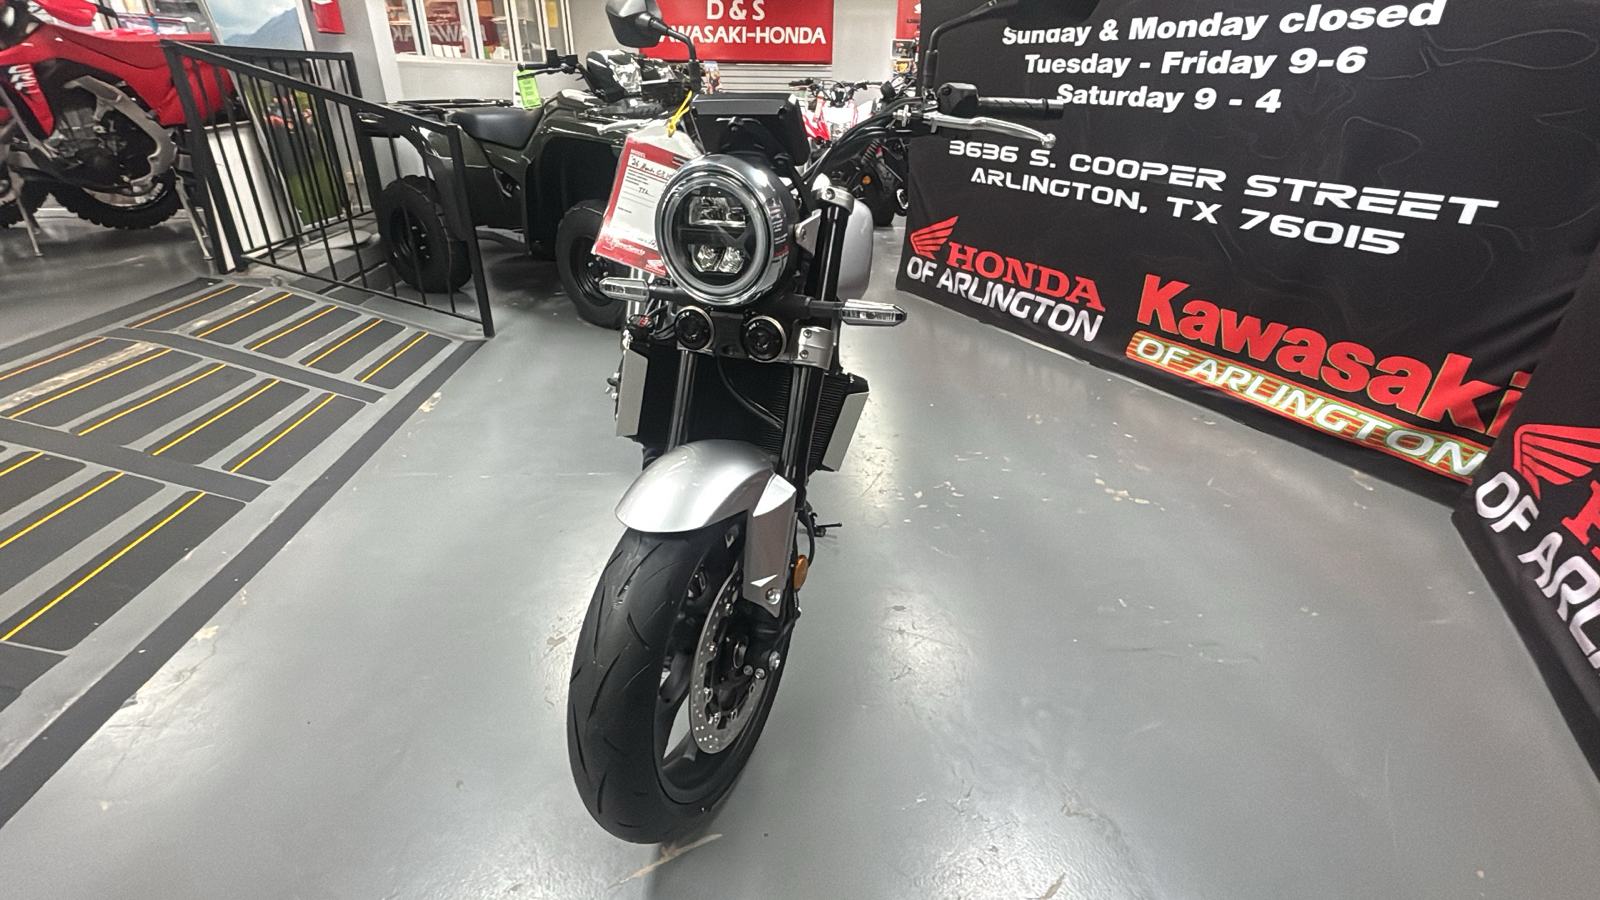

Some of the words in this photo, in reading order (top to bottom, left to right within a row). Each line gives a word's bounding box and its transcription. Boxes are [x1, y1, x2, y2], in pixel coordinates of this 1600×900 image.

[706, 0, 724, 20] D
[729, 0, 748, 20] &
[752, 0, 766, 21] S
[1099, 18, 1119, 42] &
[1128, 12, 1269, 41] Monday
[1279, 0, 1447, 34] closed
[1024, 53, 1131, 78] Tuesday
[1139, 61, 1151, 69] -
[1161, 50, 1278, 79] Friday
[1288, 46, 1368, 74] 9-6
[1056, 83, 1185, 113] Saturday
[1194, 87, 1217, 110] 9
[1229, 98, 1243, 106] -
[1255, 88, 1282, 113] 4
[949, 140, 1019, 163] 3636
[1029, 149, 1056, 168] S.
[1069, 153, 1227, 191] COOPER
[1244, 174, 1500, 225] STREET
[971, 167, 1148, 214] ARLINGTON,
[1166, 196, 1223, 224] TX
[1239, 208, 1405, 255] 76015
[907, 256, 937, 283] OF
[936, 268, 1104, 342] ARLINGTON
[946, 241, 1106, 312] HONDA
[1137, 274, 1532, 437] Kawasaki
[1136, 338, 1191, 366] OF
[1186, 359, 1488, 476] ARLINGTON
[1475, 471, 1539, 533] OF
